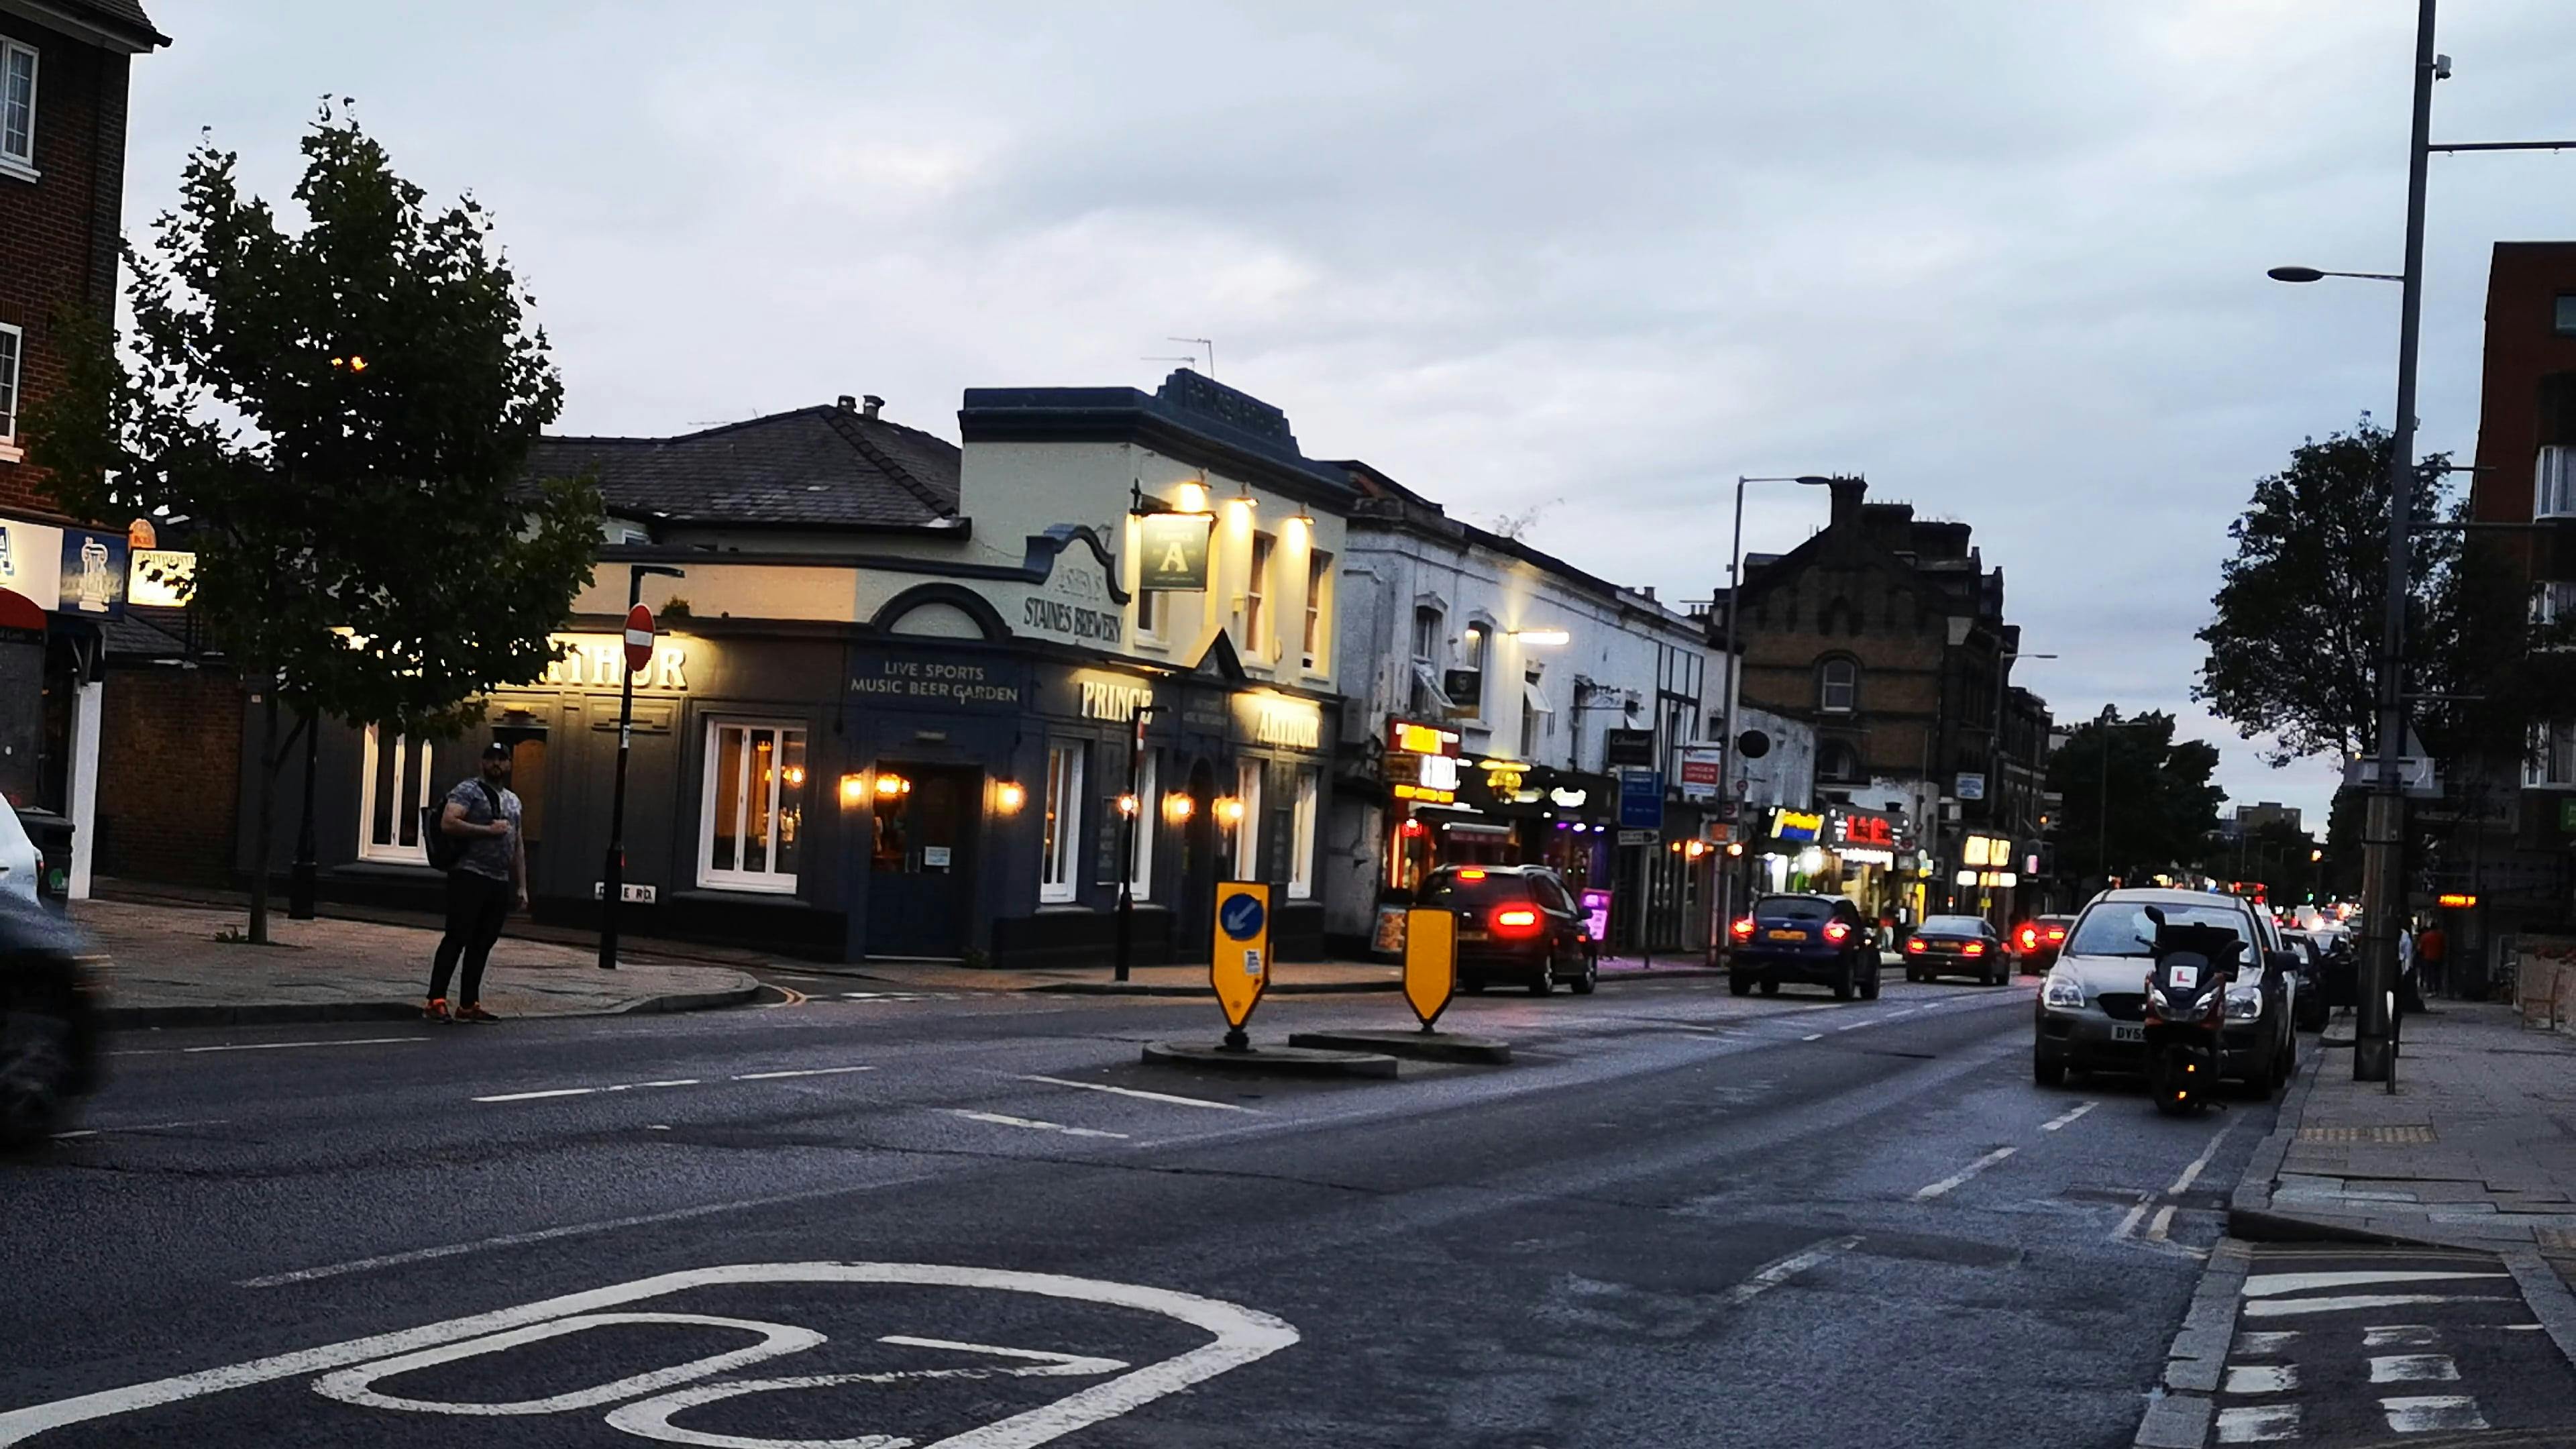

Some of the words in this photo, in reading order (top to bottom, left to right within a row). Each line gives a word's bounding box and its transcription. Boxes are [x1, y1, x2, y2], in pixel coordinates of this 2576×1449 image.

[1160, 541, 1188, 572] A
[1024, 596, 1072, 633] STAINES
[1075, 607, 1124, 643] BREWERY
[884, 661, 918, 676] LIVE
[925, 664, 984, 680] SPORTS
[850, 679, 902, 693] MUSIC
[910, 682, 949, 696] BEER
[953, 684, 1018, 704] GARDEN
[1081, 681, 1153, 724] PRINCE
[2177, 971, 2190, 982] L
